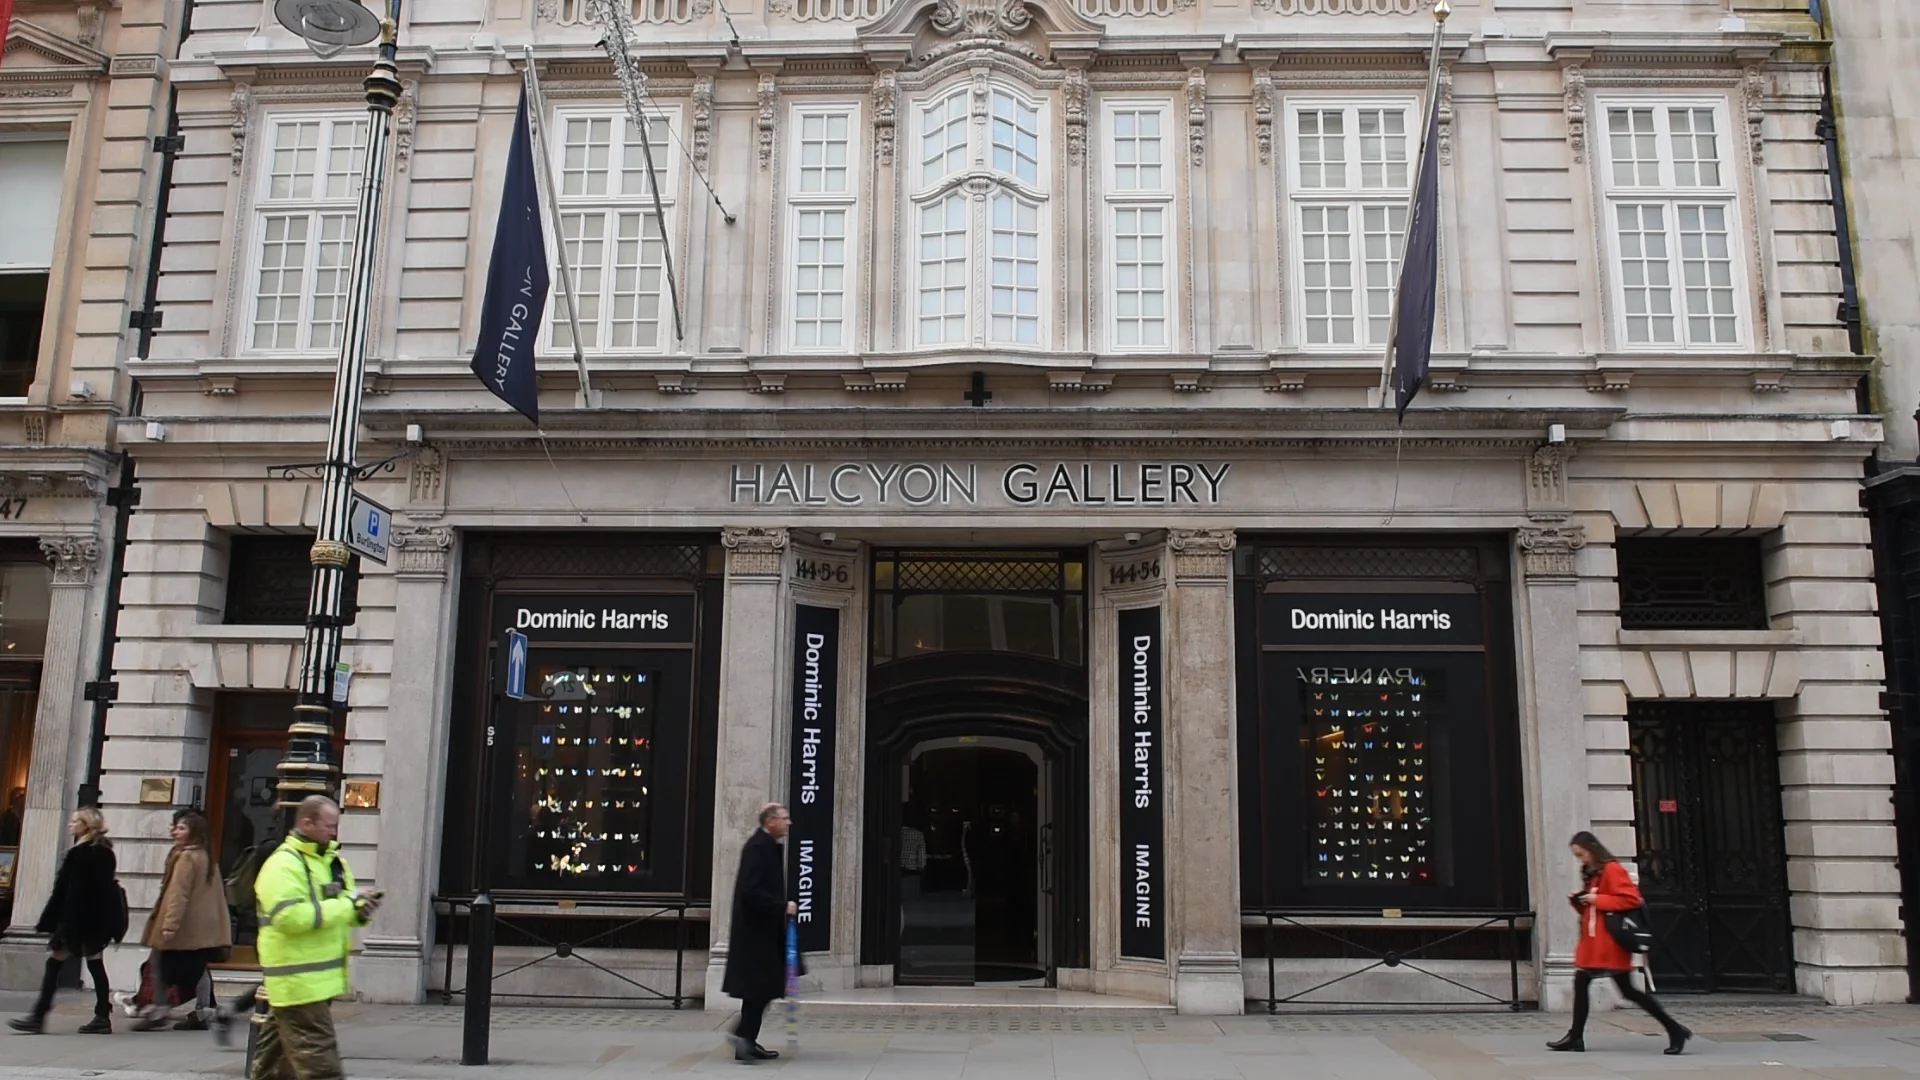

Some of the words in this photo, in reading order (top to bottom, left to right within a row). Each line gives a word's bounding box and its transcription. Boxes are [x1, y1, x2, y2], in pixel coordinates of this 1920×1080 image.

[494, 303, 529, 392] GALLERY
[728, 463, 977, 504] HALCYON
[1003, 463, 1231, 504] GALLERY
[356, 532, 386, 555] Burlington
[516, 608, 596, 629] Dominic
[601, 609, 669, 630] Harris
[1291, 608, 1375, 630] Dominic
[1380, 608, 1451, 630] Harris
[803, 632, 825, 721] Dominic
[1133, 635, 1151, 724] Dominic
[800, 727, 822, 804] Harris
[1134, 731, 1152, 809] Harris
[797, 839, 814, 924] IMAGINE
[1135, 844, 1151, 929] IMAGINE
